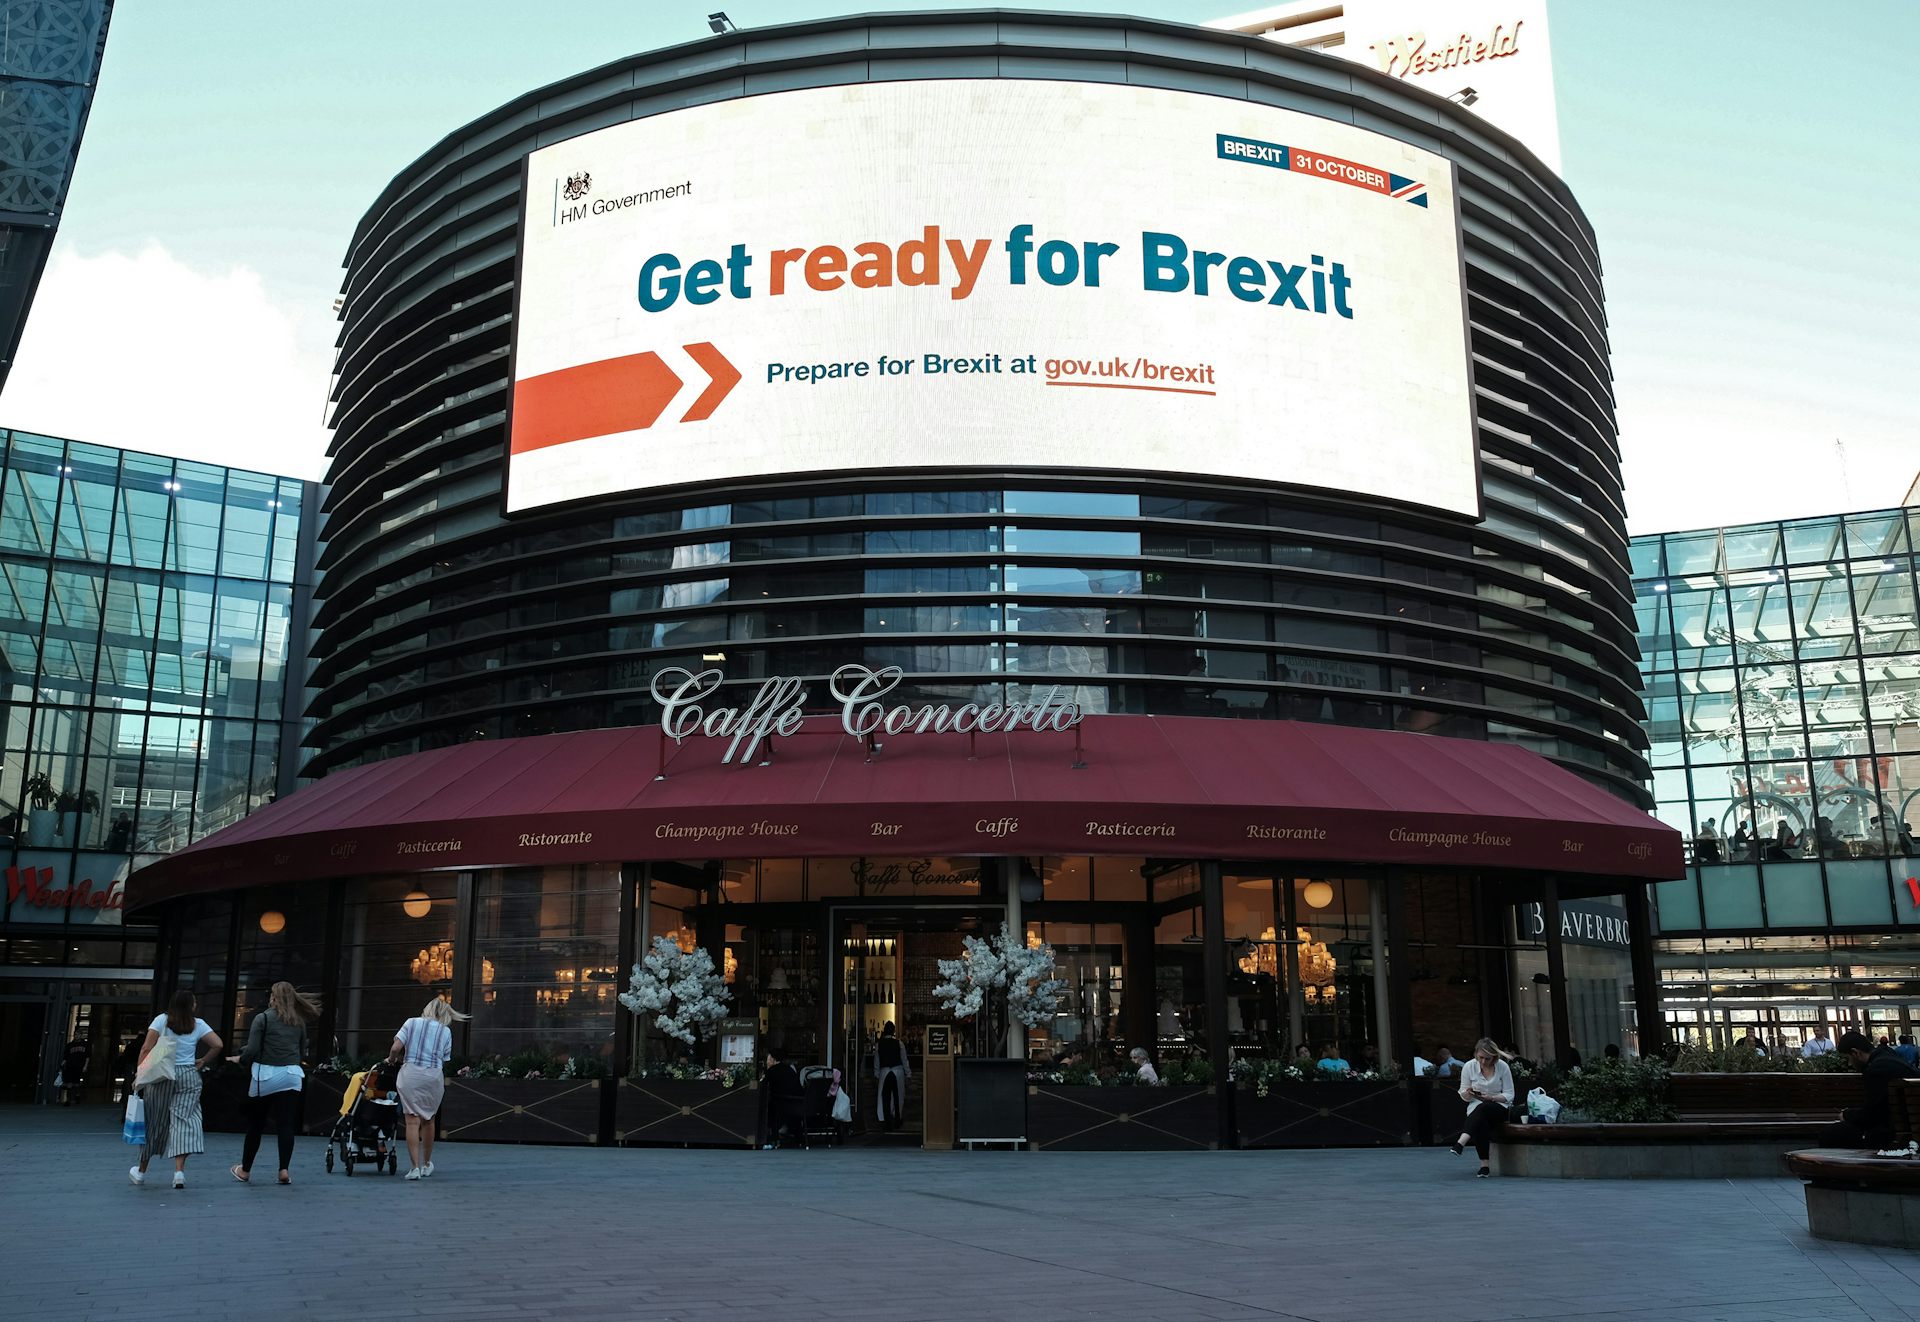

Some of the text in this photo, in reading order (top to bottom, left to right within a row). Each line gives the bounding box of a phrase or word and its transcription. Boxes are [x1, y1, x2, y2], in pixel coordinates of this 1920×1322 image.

[1368, 21, 1523, 77] Westfield
[1223, 140, 1283, 164] BREXIT
[1296, 154, 1386, 189] 31 OCTOBER
[561, 180, 692, 225] HM Government
[638, 224, 1353, 319] Get ready for Brexit
[767, 353, 1216, 386] Prepare for Brexit at gov.uk/brexit
[651, 663, 1084, 765] Caffé Concerto
[655, 820, 799, 841] Champagne House
[870, 822, 903, 836] Bar
[975, 817, 1019, 838] Caffé
[1086, 821, 1176, 837] Pasticceria
[1246, 824, 1327, 840] Ristorante
[1389, 827, 1512, 847] Champagne House
[397, 838, 463, 854] Pasticceria
[518, 831, 593, 847] Ristorante
[1562, 839, 1584, 853] Bar
[908, 858, 984, 886] Concert
[1530, 901, 1630, 945] BAVERBRO
